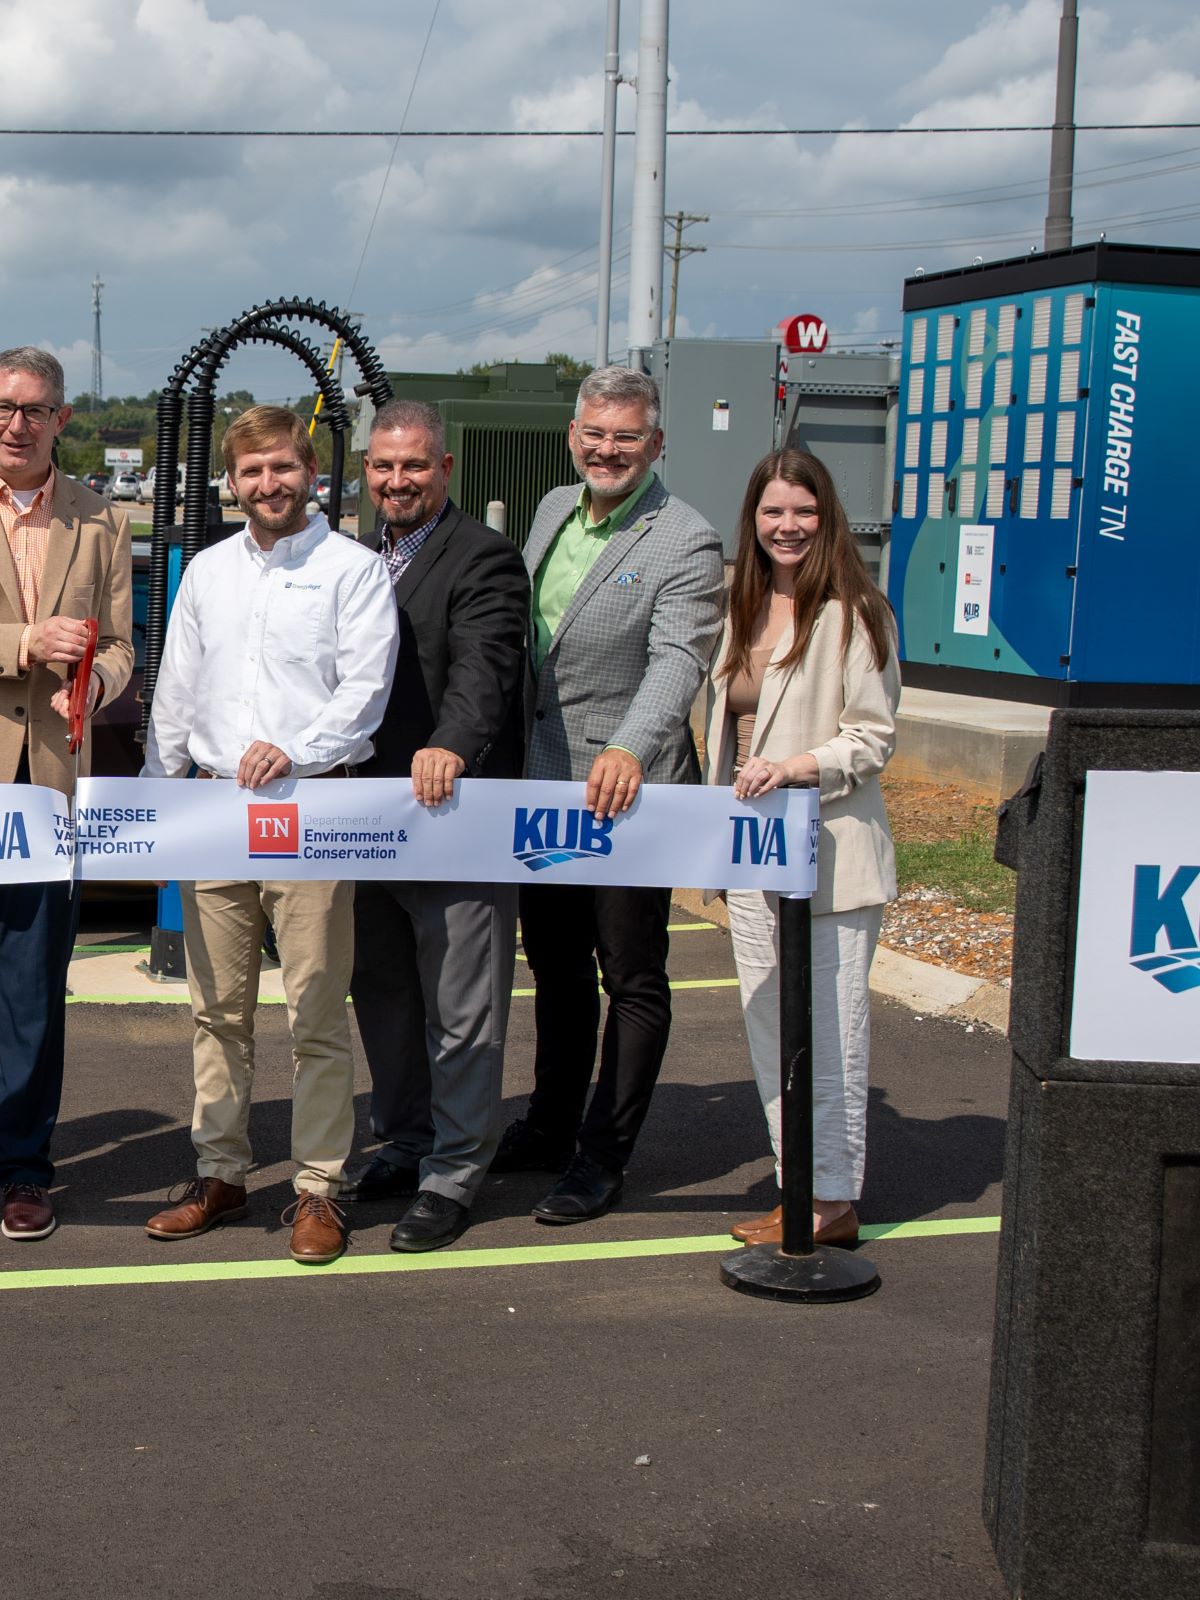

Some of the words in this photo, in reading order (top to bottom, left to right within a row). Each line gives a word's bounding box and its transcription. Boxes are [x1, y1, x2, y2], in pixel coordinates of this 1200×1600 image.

[797, 321, 827, 349] W
[1112, 309, 1141, 382] FAST
[1103, 383, 1136, 497] CHARGE
[1098, 504, 1127, 541] TN
[53, 808, 156, 829] TENNESSEE
[256, 817, 289, 838] TN
[304, 815, 368, 827] Department
[372, 815, 383, 825] of
[304, 829, 394, 843] Environment
[397, 829, 408, 842] &
[513, 807, 613, 856] KUB
[729, 816, 787, 866] TVA
[55, 841, 155, 856] AUTHORITY
[303, 846, 396, 859] Conservation
